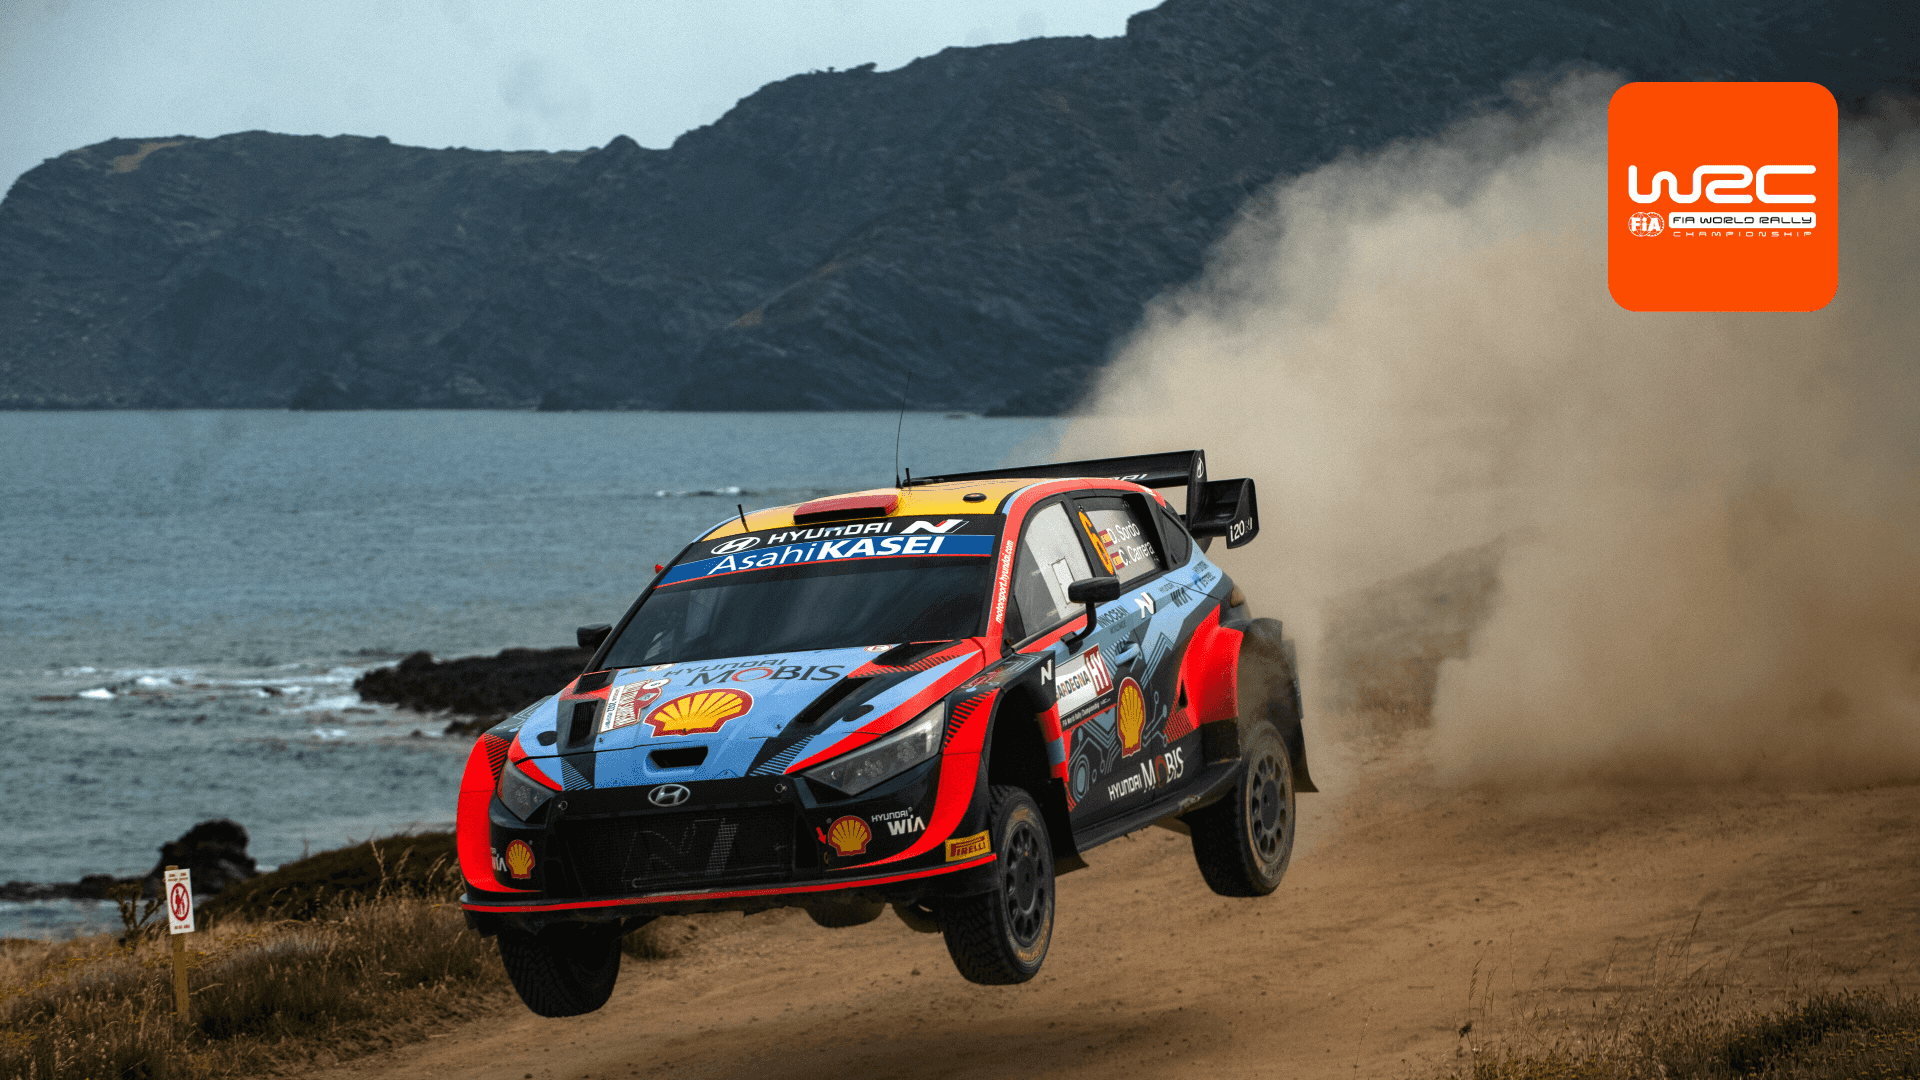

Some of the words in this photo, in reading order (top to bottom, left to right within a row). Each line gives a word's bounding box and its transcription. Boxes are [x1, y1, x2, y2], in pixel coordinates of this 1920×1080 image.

[767, 521, 893, 545] HYUNDAI
[1114, 520, 1141, 541] Sordo
[1230, 520, 1245, 543] i20
[1078, 511, 1114, 575] 6
[1126, 541, 1155, 563] Carrera
[995, 539, 1014, 624] motorsport.hyundai.com
[664, 658, 788, 678] HYUNDAI
[686, 665, 846, 688] MOBIS
[1107, 773, 1143, 802] HYUNDAI
[1139, 746, 1184, 794] MOBIS
[871, 809, 909, 823] HYUNDAI
[949, 834, 986, 858] PIRELLI
